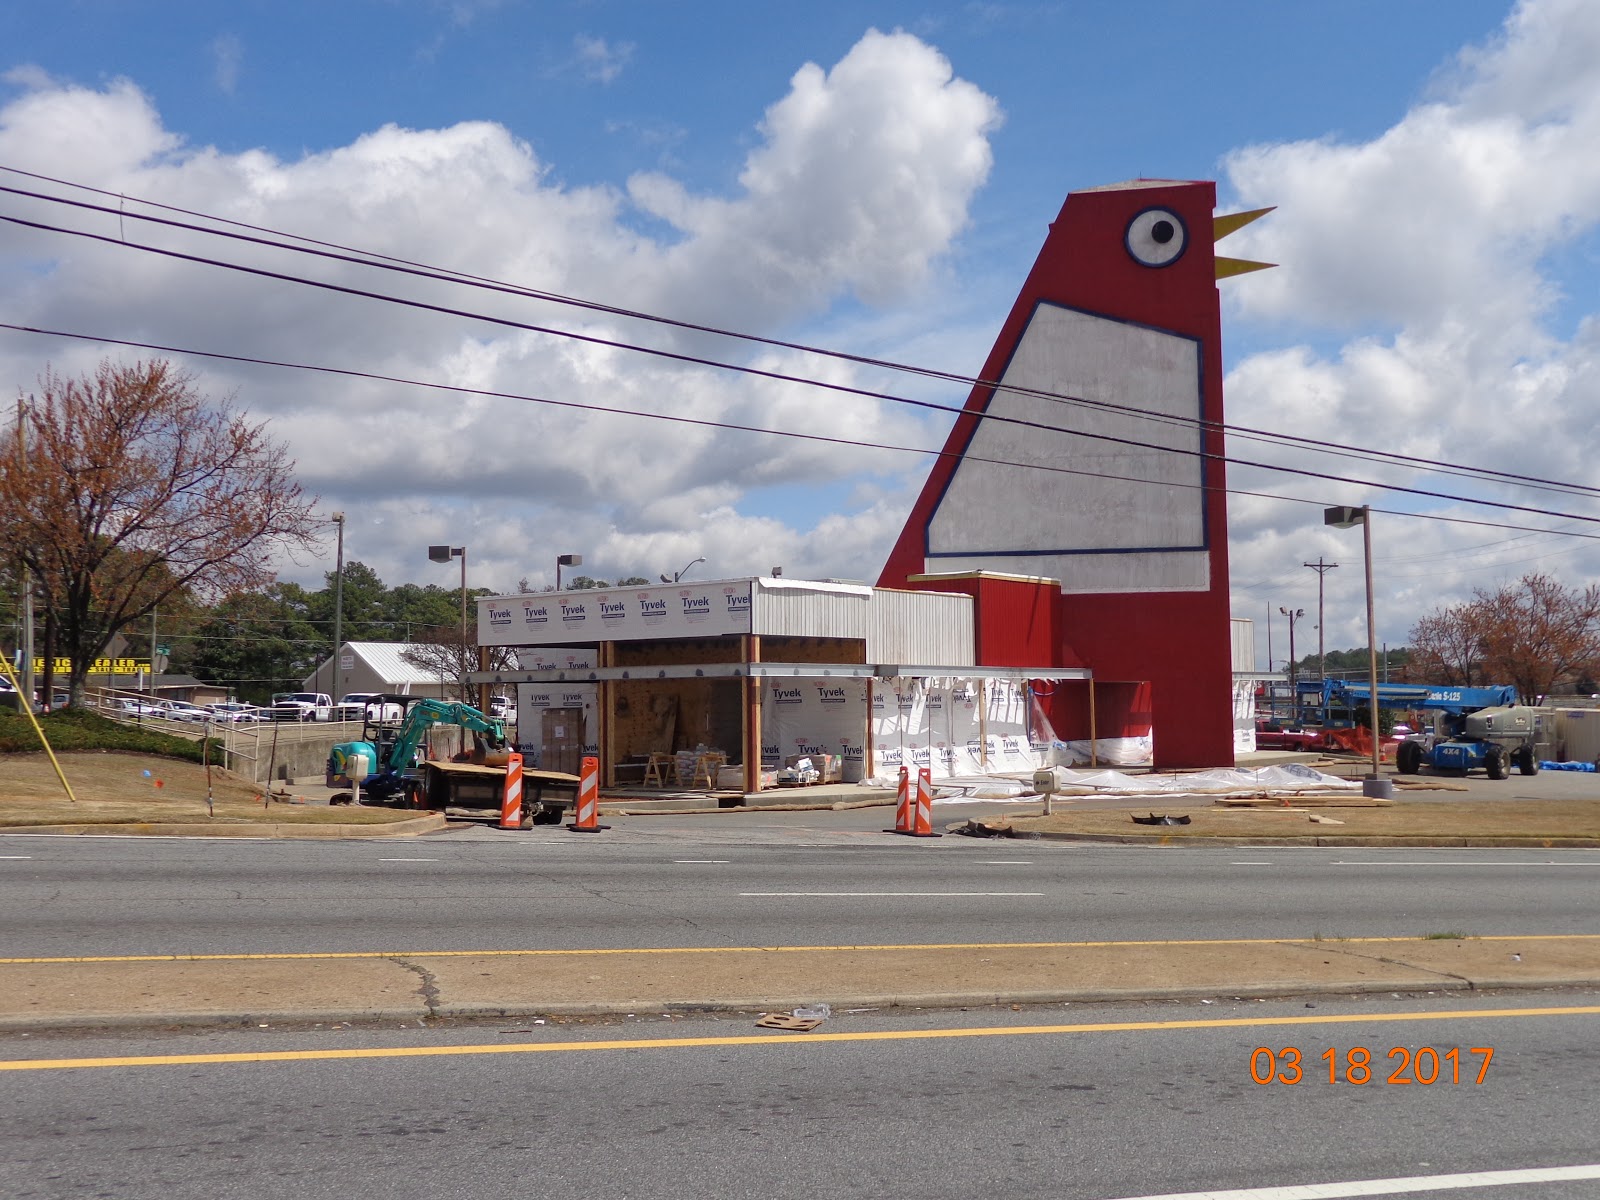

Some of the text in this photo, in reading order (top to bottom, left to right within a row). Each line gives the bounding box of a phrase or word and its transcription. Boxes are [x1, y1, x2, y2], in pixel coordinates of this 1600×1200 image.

[600, 602, 625, 614] Tyvek
[640, 599, 666, 611] Tyvek
[682, 596, 710, 609] Tyvek
[489, 609, 511, 620] Tyvek
[525, 607, 547, 618] Tyvek
[561, 604, 585, 616] Tyvek
[773, 688, 802, 699] Tyvek
[817, 687, 845, 698] Tyvek
